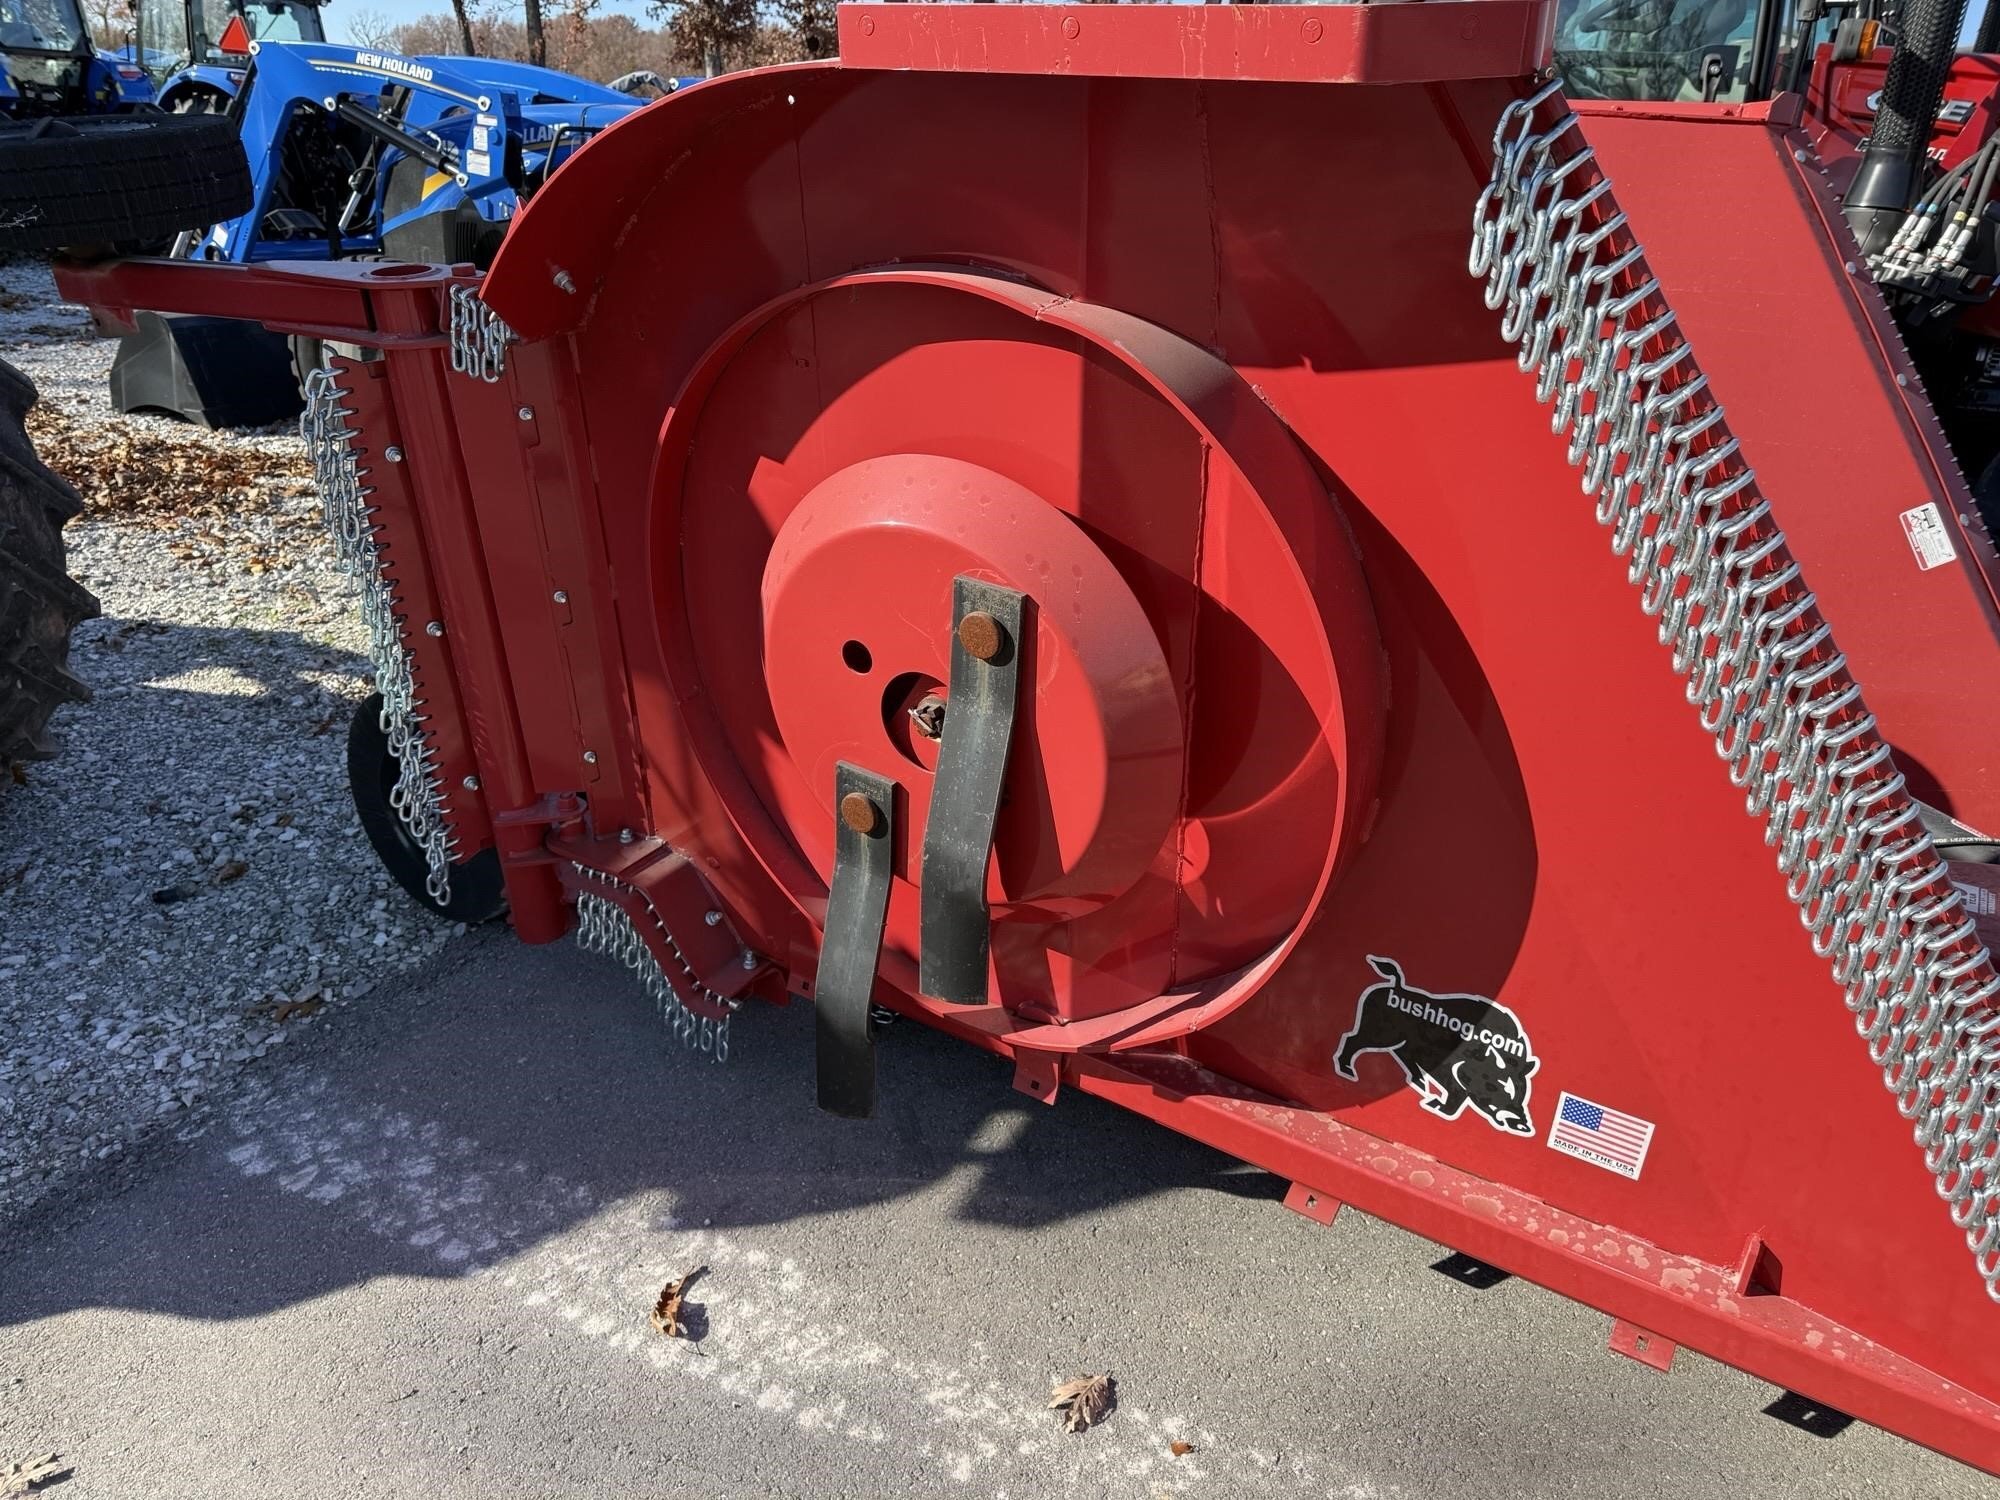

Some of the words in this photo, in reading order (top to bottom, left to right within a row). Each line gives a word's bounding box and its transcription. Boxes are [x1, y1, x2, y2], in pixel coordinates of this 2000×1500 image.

[356, 52, 381, 67] NEW
[382, 57, 432, 81] HOLLAND
[1386, 989, 1524, 1057] bushhog.com
[1553, 1139, 1580, 1151] MADE
[1581, 1149, 1592, 1157] IN
[1594, 1154, 1613, 1164] THE
[1615, 1162, 1635, 1173] USA
